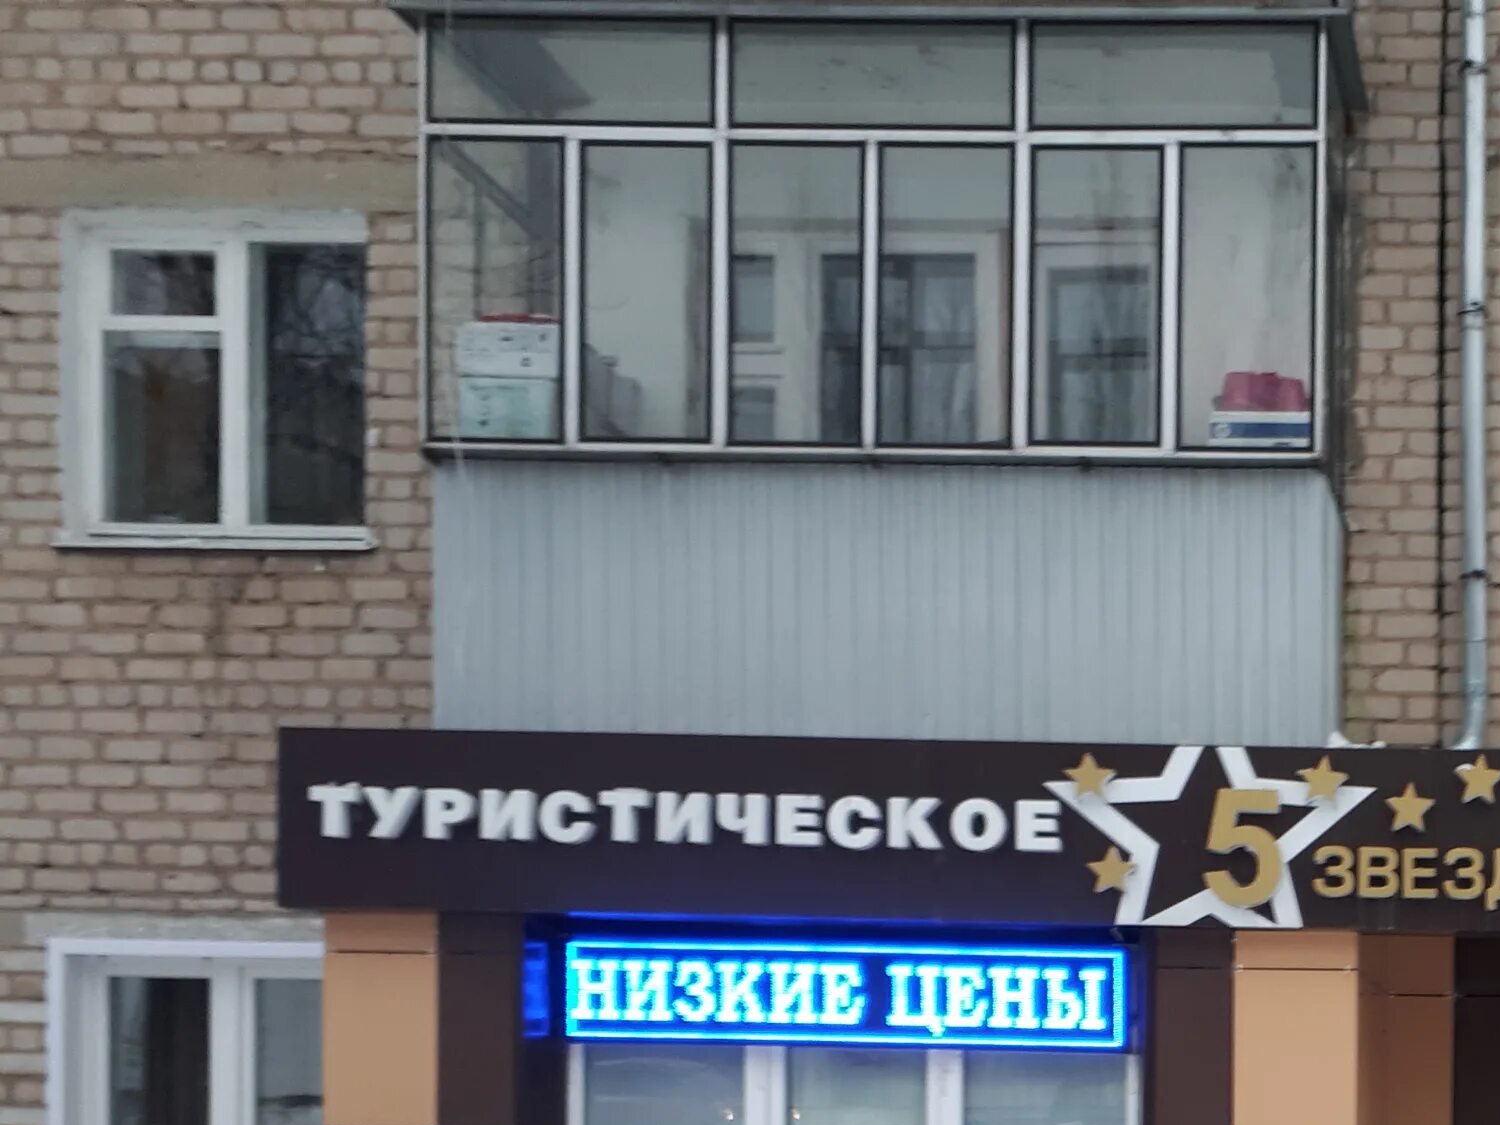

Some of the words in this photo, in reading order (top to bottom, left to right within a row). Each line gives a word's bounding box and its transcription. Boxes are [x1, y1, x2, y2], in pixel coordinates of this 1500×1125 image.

[308, 783, 1064, 852] ТУРИСТИЧЕСКОЕ
[1203, 788, 1283, 908] 5
[569, 957, 865, 1026] НИЗКИЕ
[886, 963, 1107, 1036] ЦЕНЫ
